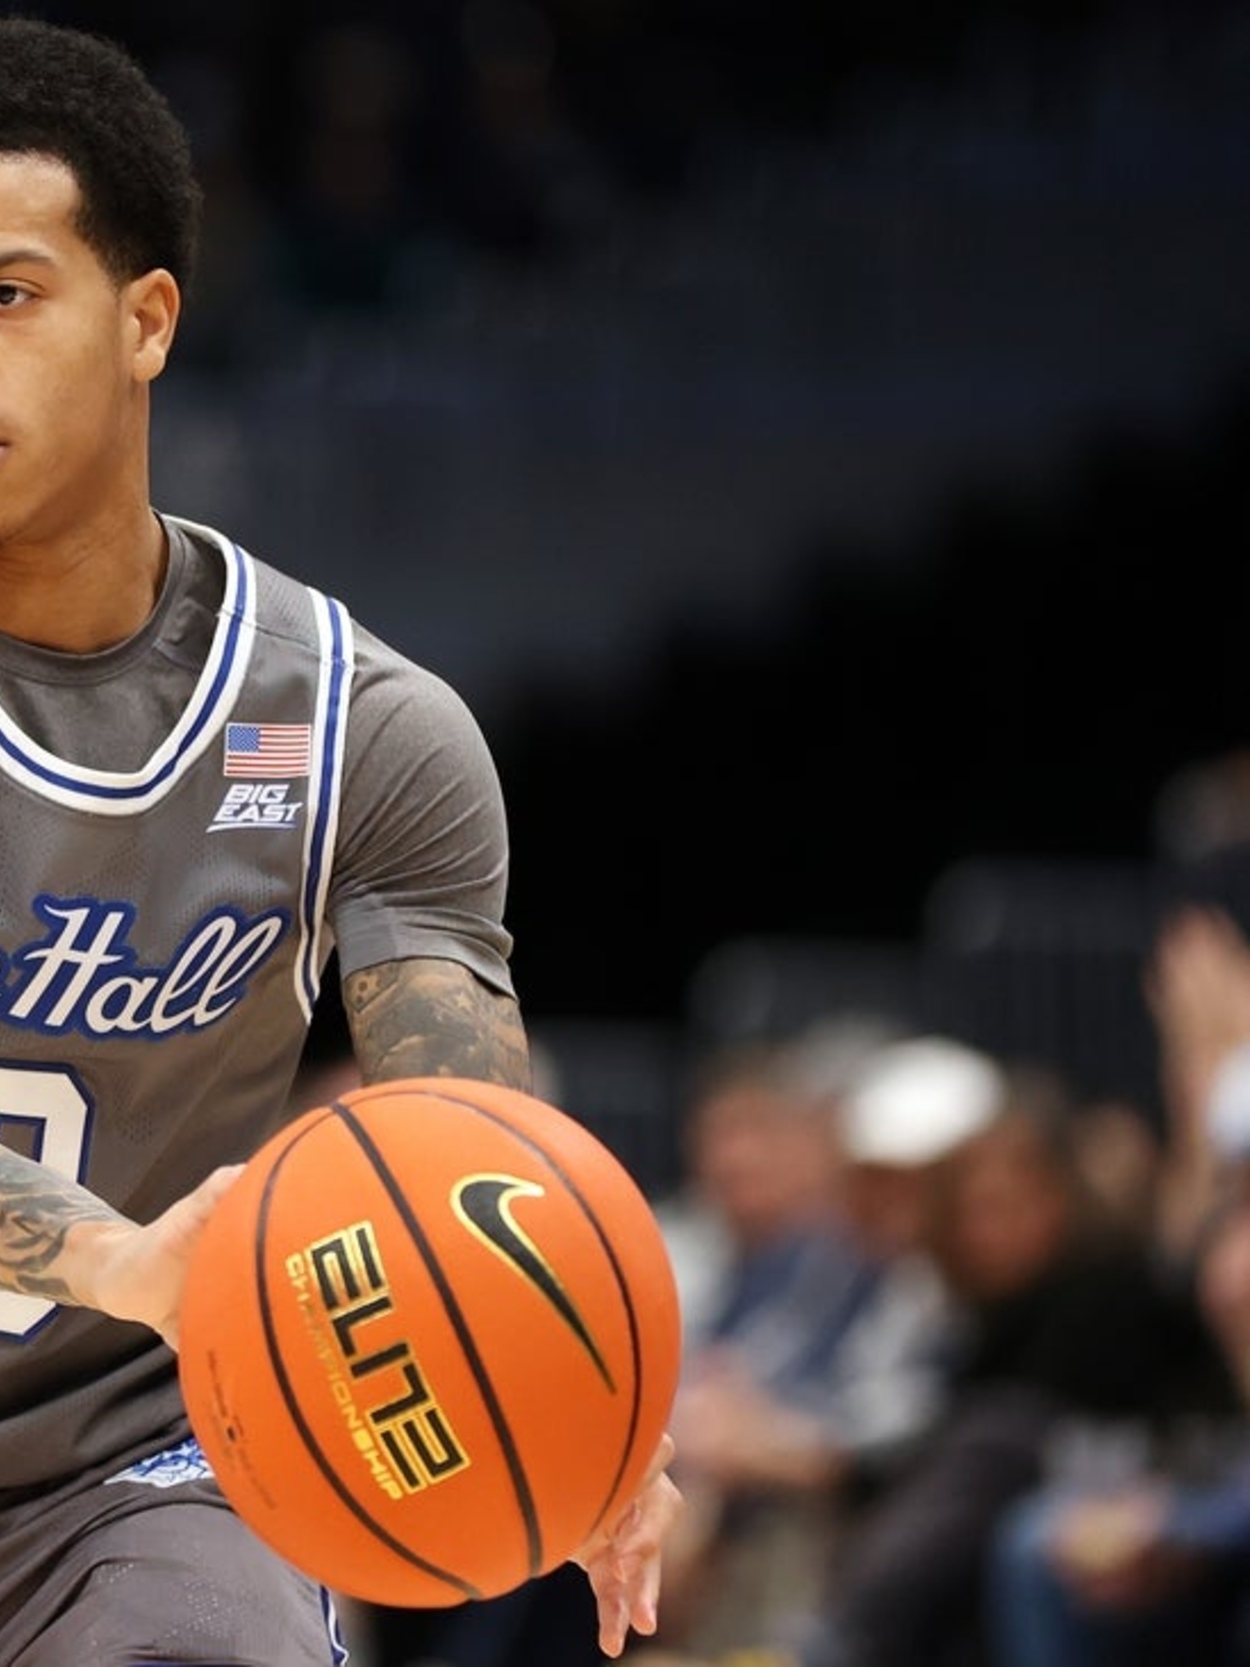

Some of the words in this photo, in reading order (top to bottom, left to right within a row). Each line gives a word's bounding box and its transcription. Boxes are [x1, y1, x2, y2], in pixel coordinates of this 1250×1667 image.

[213, 802, 304, 822] EAST
[222, 784, 290, 804] BIG
[8, 903, 283, 1034] Hall
[307, 1220, 471, 1495] ELITE
